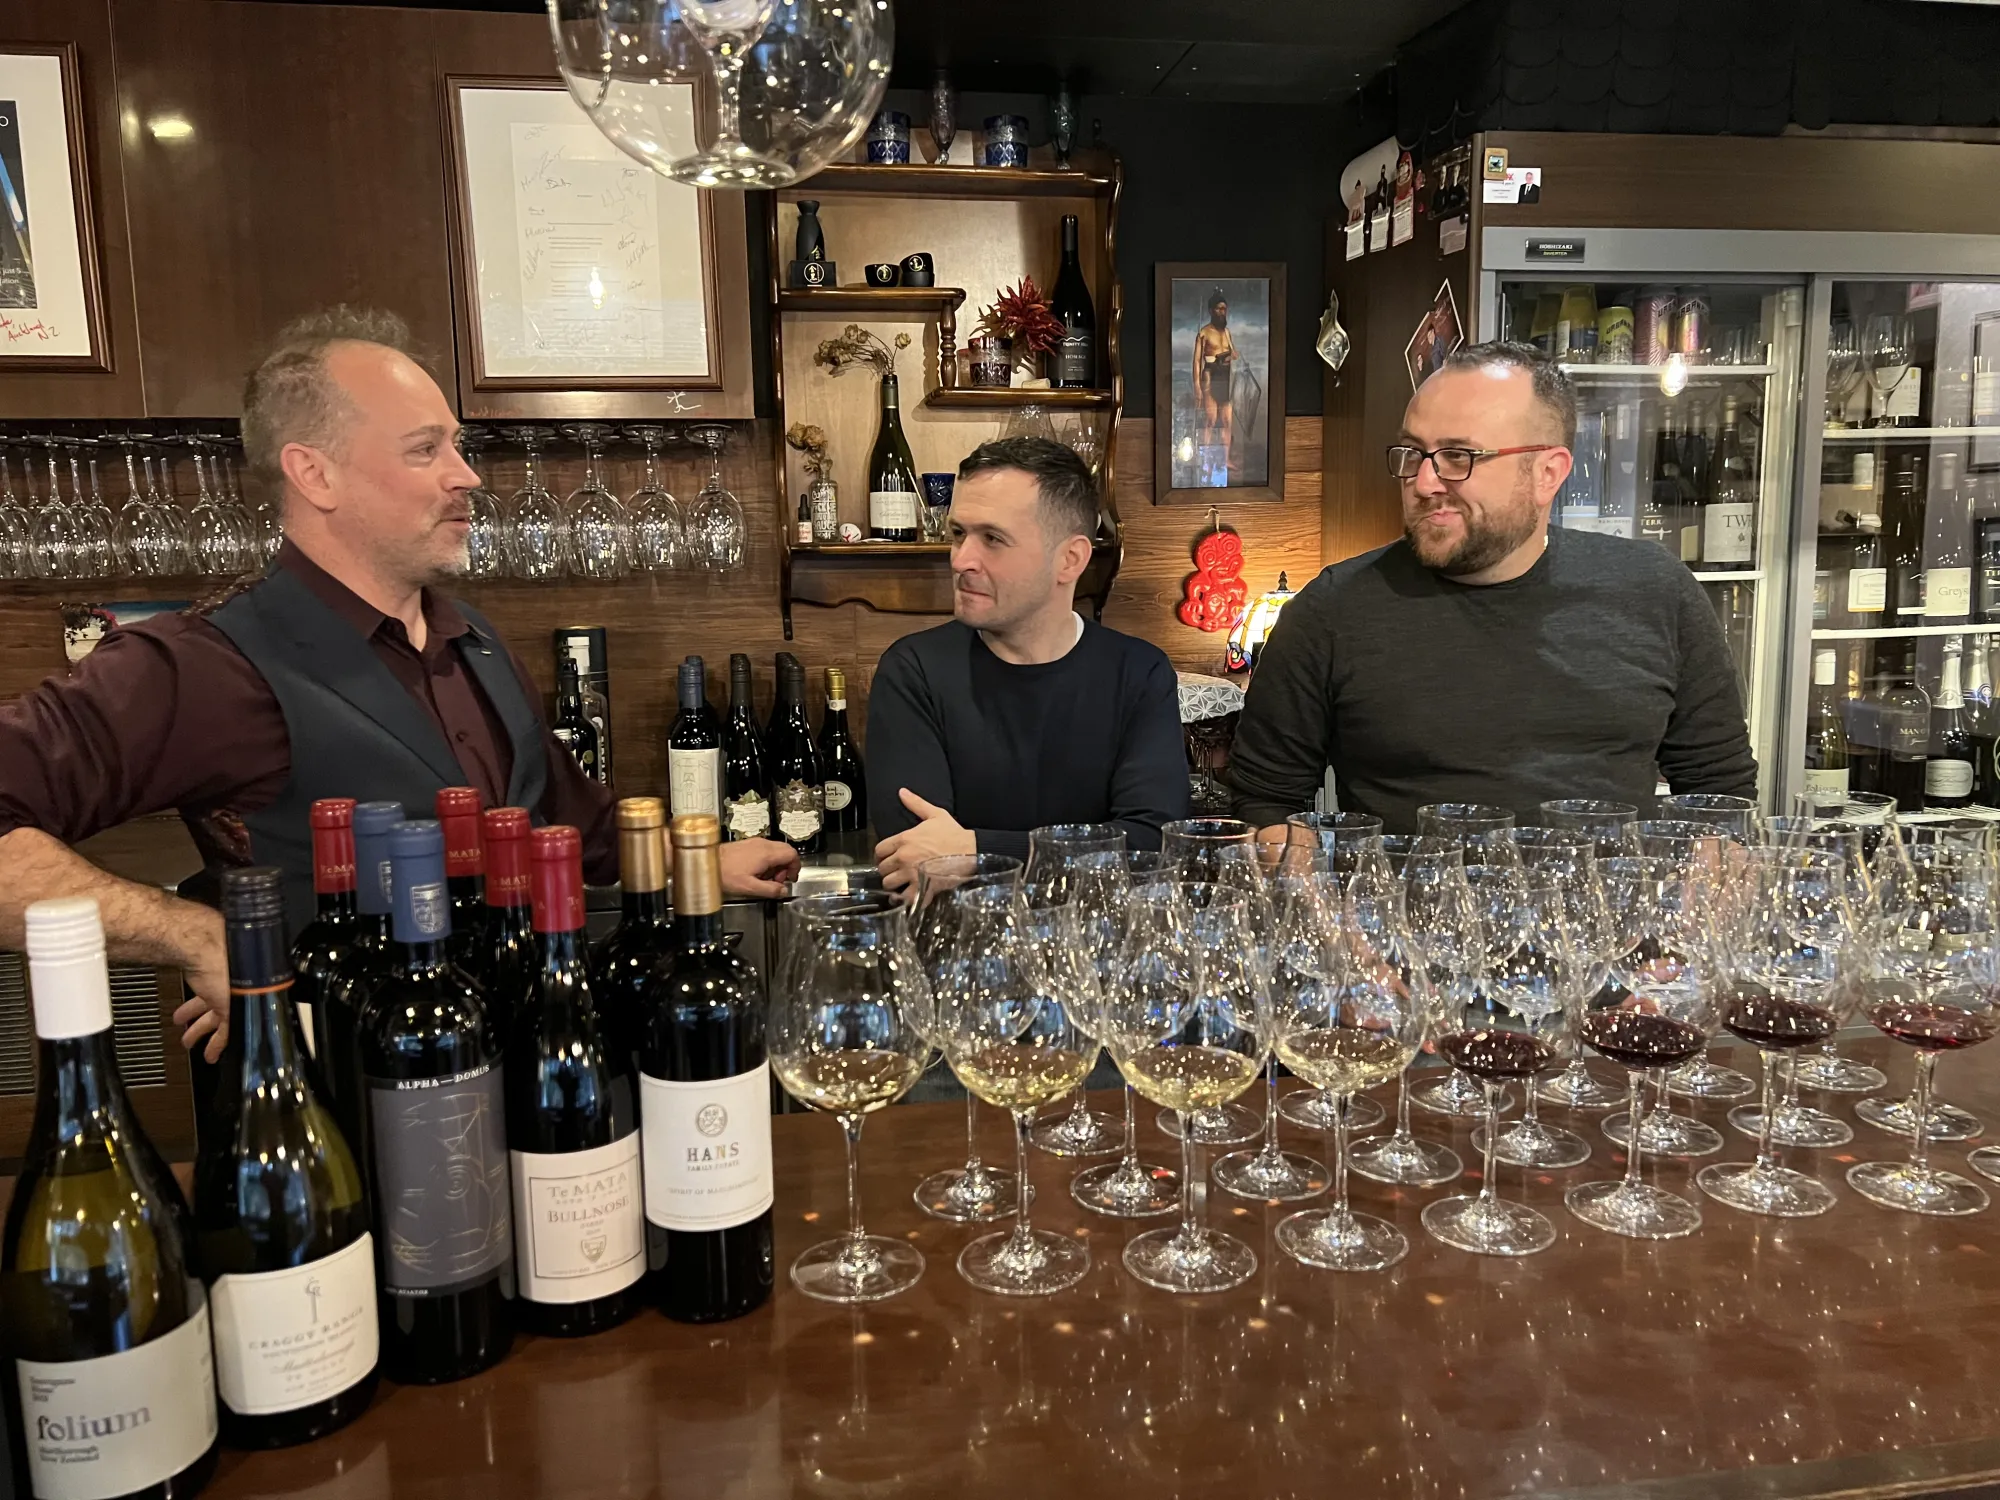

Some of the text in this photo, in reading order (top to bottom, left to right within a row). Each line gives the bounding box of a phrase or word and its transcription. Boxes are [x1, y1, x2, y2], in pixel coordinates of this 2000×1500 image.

[686, 1141, 740, 1162] HANS
[687, 1164, 713, 1172] FAMILY
[547, 1186, 568, 1198] Te
[573, 1171, 627, 1197] MATA
[547, 1195, 630, 1223] BULLNOSE
[37, 1407, 152, 1441] folium
